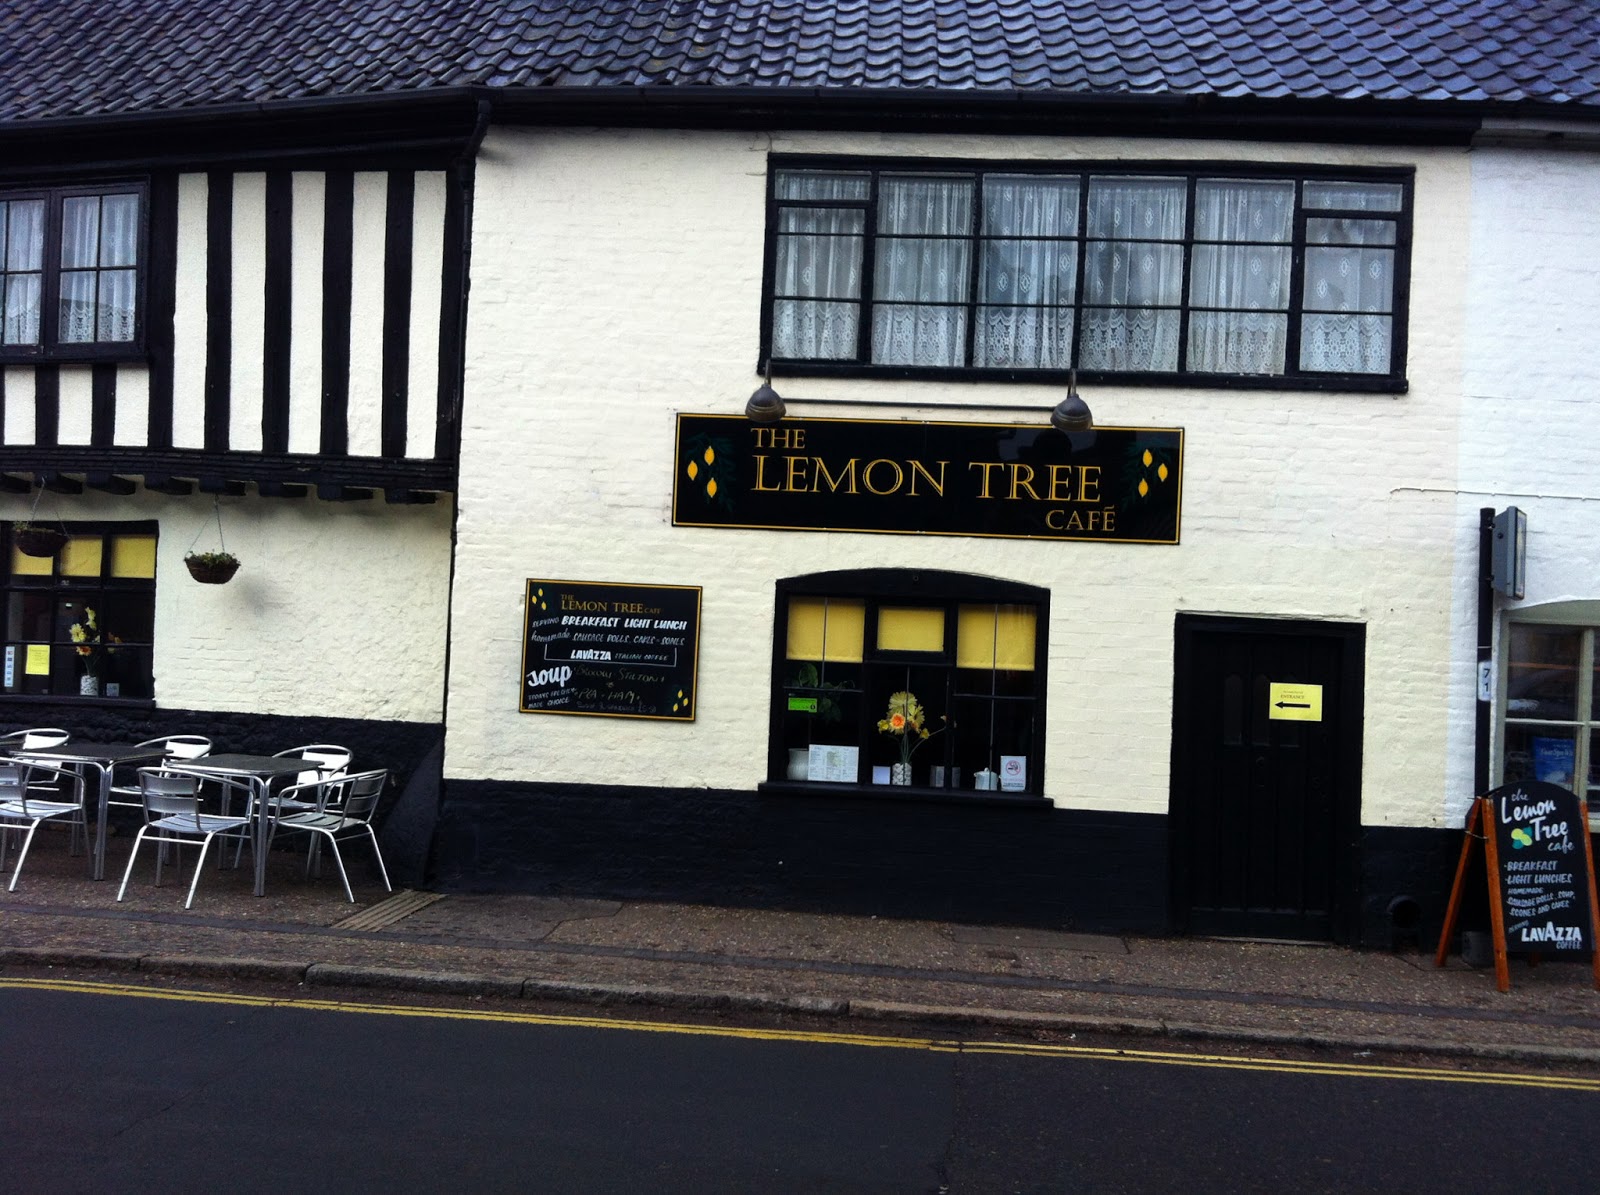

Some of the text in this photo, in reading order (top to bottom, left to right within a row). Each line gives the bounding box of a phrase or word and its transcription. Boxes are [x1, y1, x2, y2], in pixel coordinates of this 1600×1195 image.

[751, 427, 806, 449] THE
[751, 454, 1102, 503] LEMON TREE
[1045, 505, 1116, 533] CAFÉ
[561, 600, 608, 612] LEMON
[613, 602, 644, 613] TREE
[561, 615, 621, 628] BREAKFAST
[623, 617, 653, 630] LIGHT
[653, 619, 688, 630] LUNCH
[570, 648, 612, 661] LAVAZZA
[1501, 796, 1556, 824] Lemon
[1529, 816, 1569, 841] Tree
[1507, 860, 1558, 871] BREAKFAST
[1507, 873, 1573, 885] LIGHT LUNCHES
[1521, 921, 1583, 942] LAVAZZA
[1556, 941, 1581, 950] COFFEE
